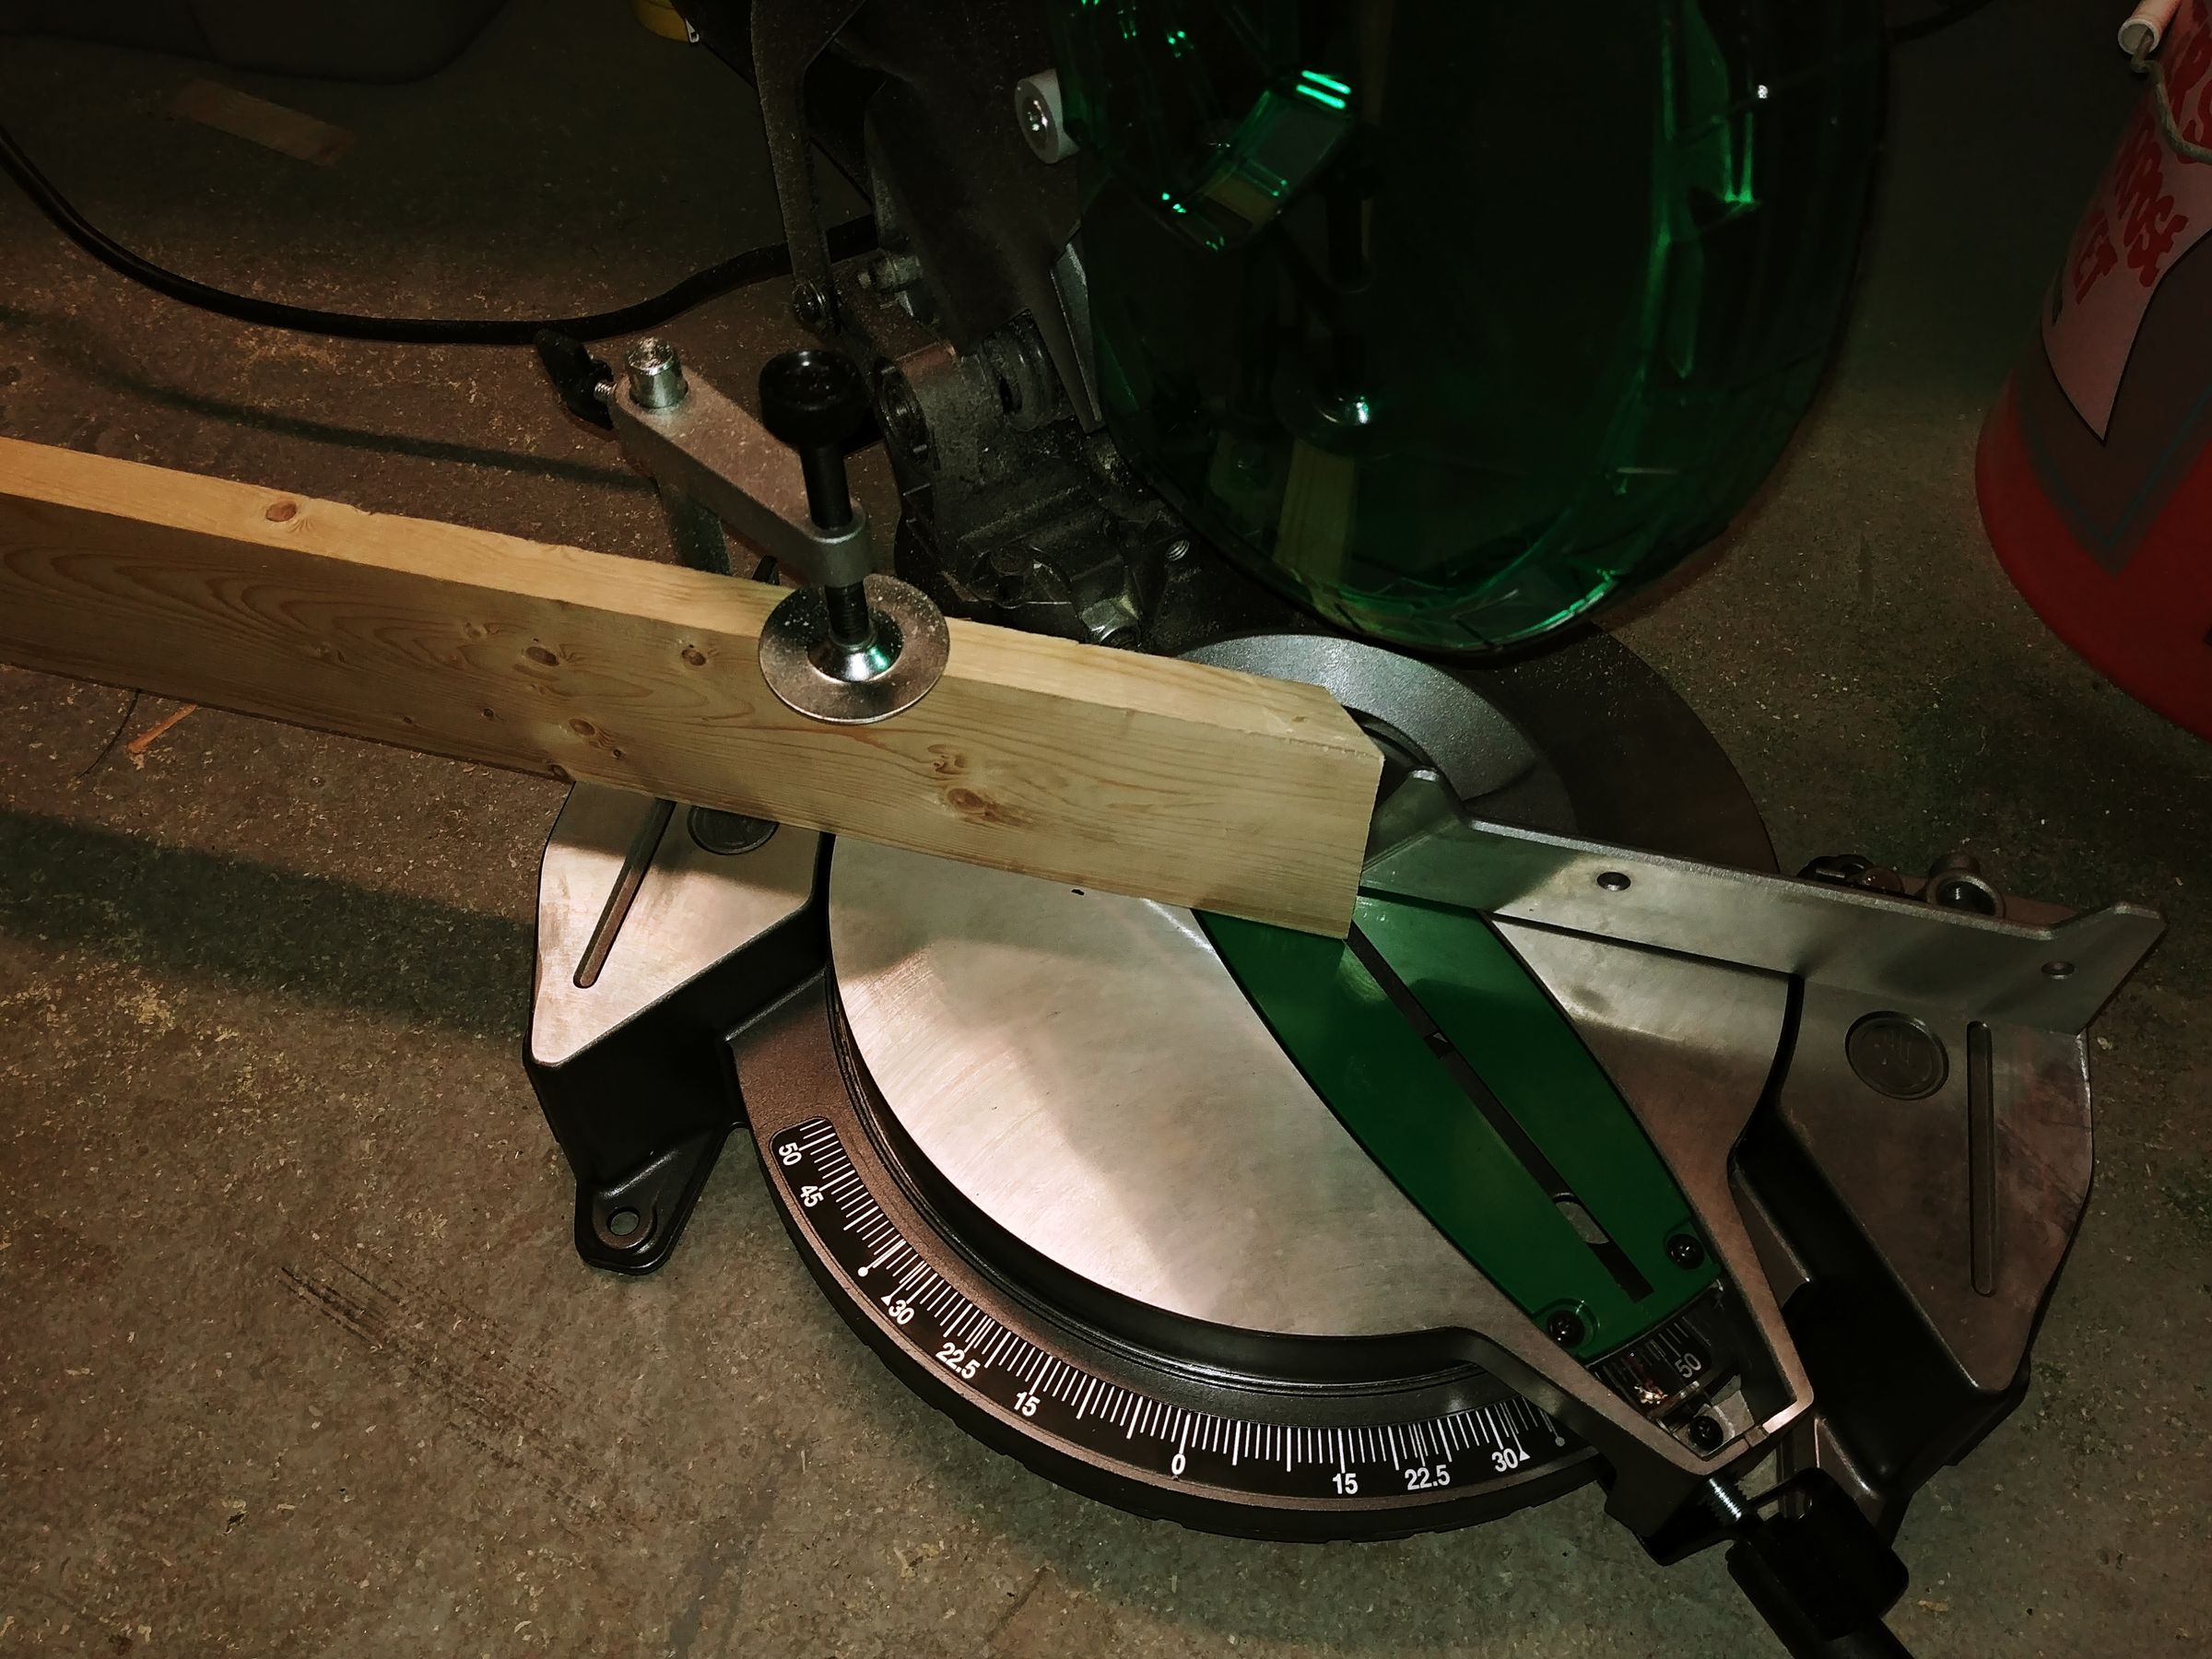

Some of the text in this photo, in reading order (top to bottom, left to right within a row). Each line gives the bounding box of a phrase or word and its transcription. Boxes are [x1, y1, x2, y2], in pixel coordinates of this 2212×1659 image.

[778, 1142, 802, 1166] 50
[799, 1183, 824, 1207] 45
[888, 1300, 915, 1325] 30
[935, 1342, 981, 1380] 22.5
[1674, 1352, 1702, 1379] 50
[1014, 1391, 1041, 1418] 15
[1171, 1453, 1186, 1476] 0
[1491, 1449, 1519, 1473] 30
[1331, 1473, 1359, 1494] 15
[1404, 1464, 1451, 1490] 22.5
